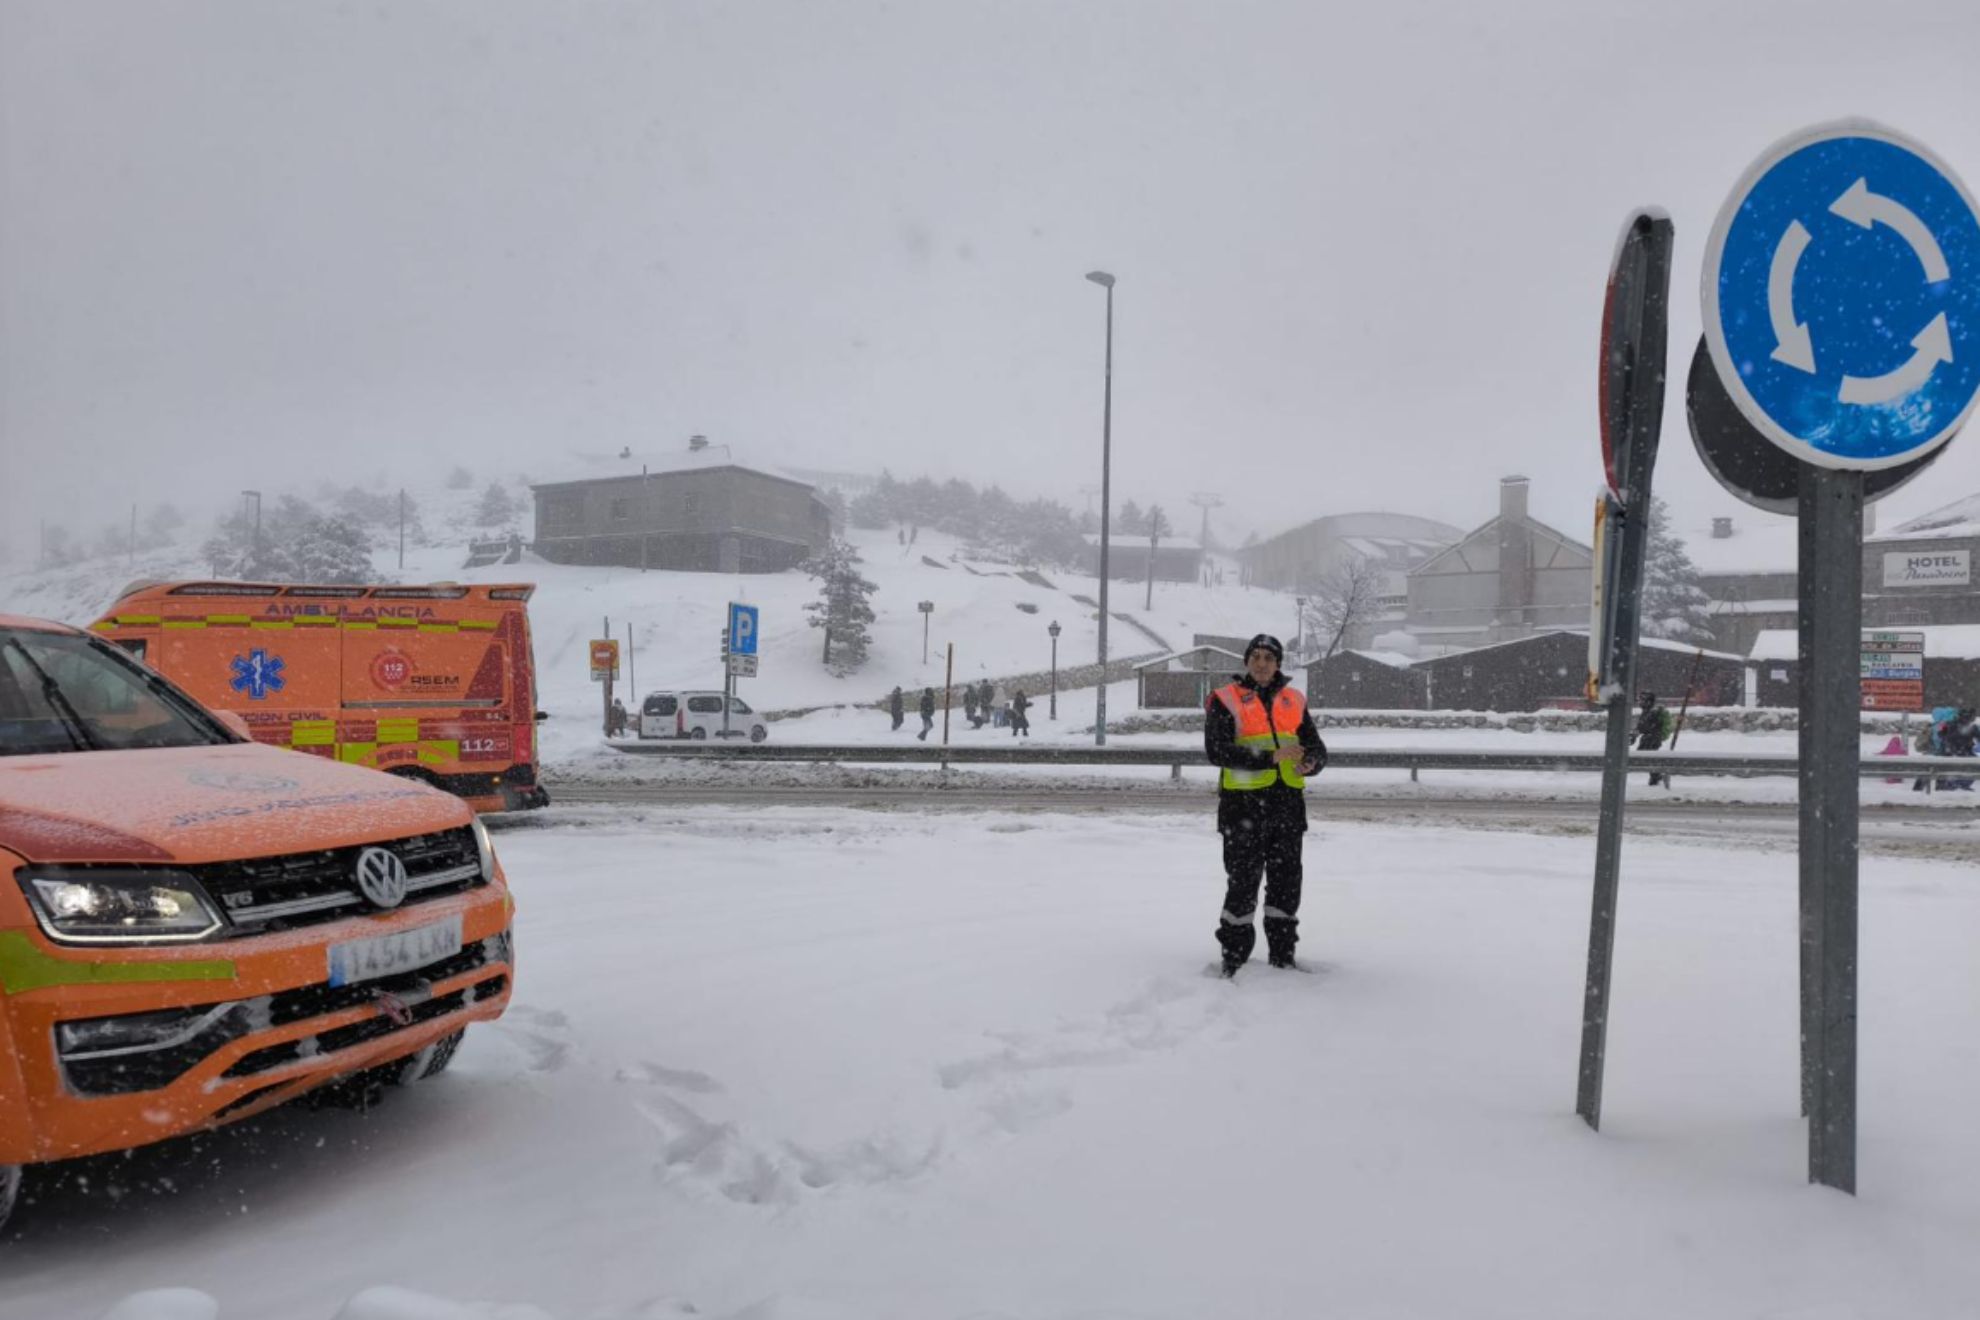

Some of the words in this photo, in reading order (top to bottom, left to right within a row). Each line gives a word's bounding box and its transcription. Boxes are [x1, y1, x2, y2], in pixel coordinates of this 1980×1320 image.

[1907, 555, 1961, 567] HOTEL
[265, 603, 436, 618] AMBULANCIA
[736, 611, 753, 649] P
[384, 663, 404, 671] 112
[411, 675, 460, 685] RSEM
[287, 711, 328, 721] CIVIL
[462, 738, 494, 752] 112
[221, 891, 253, 909] V6
